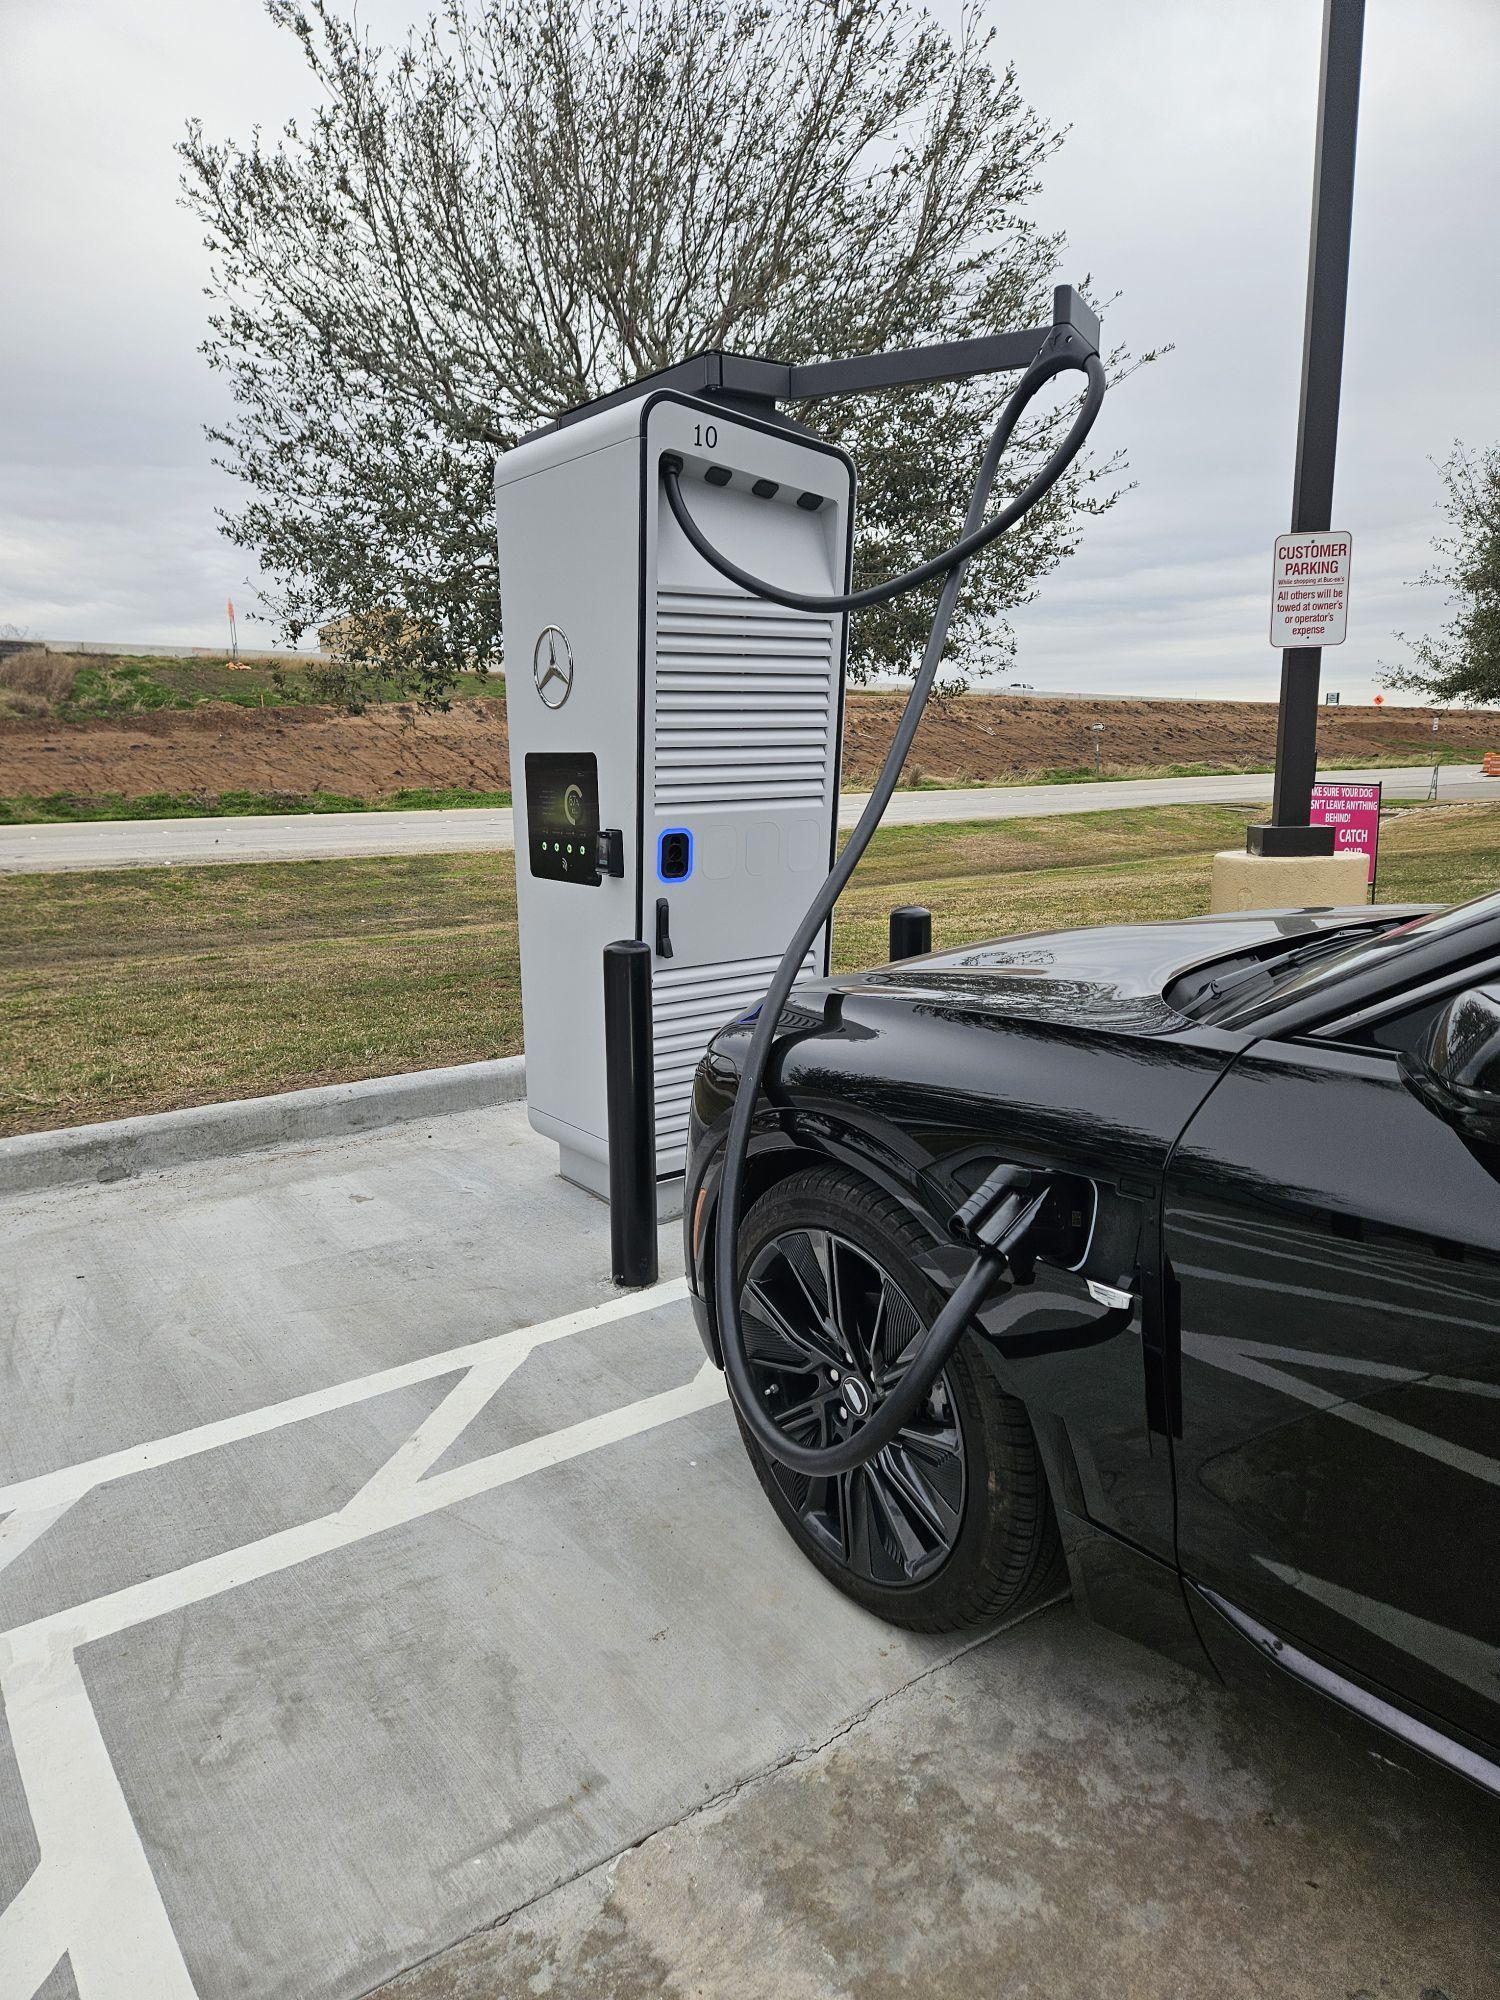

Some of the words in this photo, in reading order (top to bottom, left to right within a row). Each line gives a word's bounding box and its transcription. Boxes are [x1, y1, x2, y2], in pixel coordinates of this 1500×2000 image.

[693, 424, 718, 448] 10
[1279, 543, 1347, 560] CUSTOMER
[1285, 560, 1339, 576] PARKING
[1278, 591, 1289, 600] All
[1290, 590, 1316, 600] others
[1317, 589, 1332, 598] will
[1333, 588, 1343, 598] be
[1277, 602, 1301, 612] towed
[1302, 602, 1311, 611] at
[1312, 600, 1343, 611] owner's
[1285, 616, 1294, 624] or
[1294, 612, 1334, 625] operator's
[1292, 626, 1325, 636] expense
[1323, 787, 1340, 797] SURE
[1341, 787, 1359, 798] YOUR
[1359, 788, 1373, 798] DOG
[1326, 800, 1346, 810] LEAVE
[1346, 801, 1378, 811] ANYTHING
[1325, 813, 1351, 823] BEHIND!
[1339, 829, 1369, 843] CATCH
